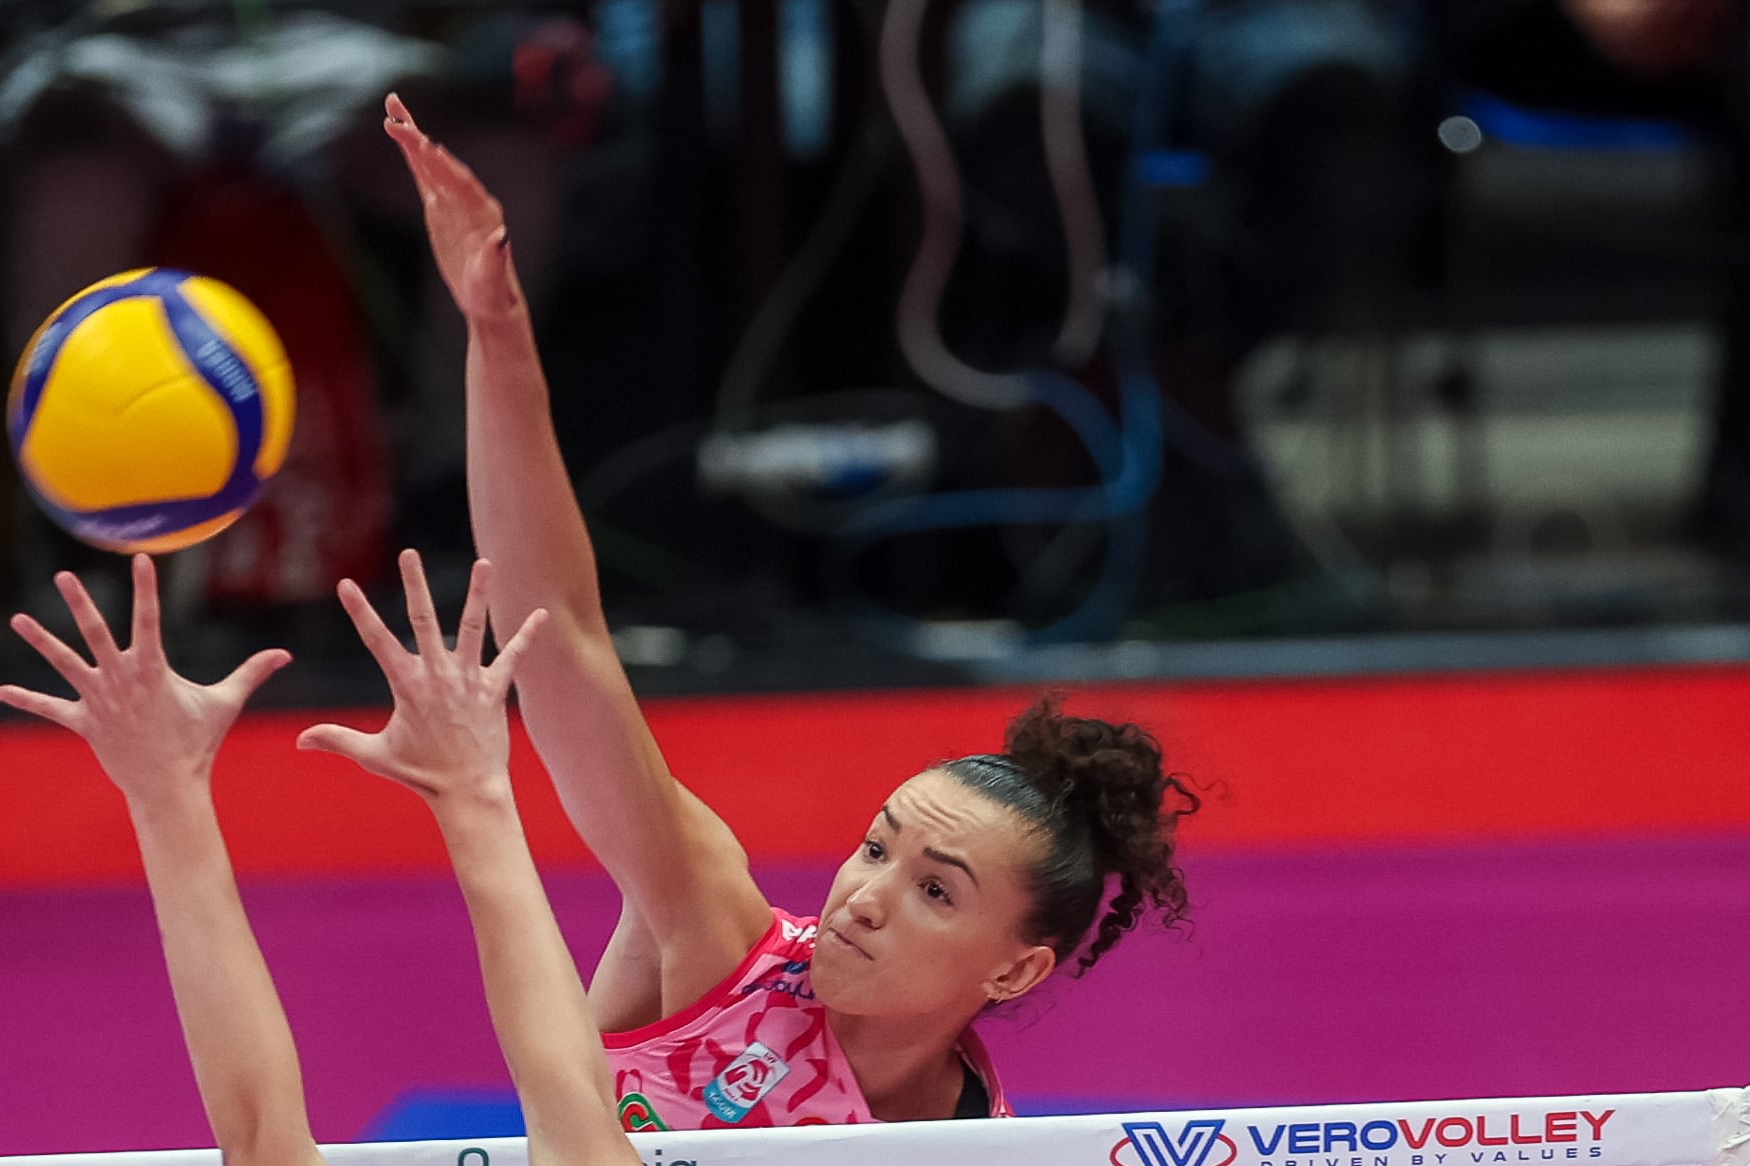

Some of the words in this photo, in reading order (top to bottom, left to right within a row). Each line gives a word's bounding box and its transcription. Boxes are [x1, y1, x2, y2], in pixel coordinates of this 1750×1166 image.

[1247, 1109, 1616, 1156] VEROVOLLEY
[1411, 1153, 1447, 1166] BY
[1470, 1146, 1603, 1163] VALUES
